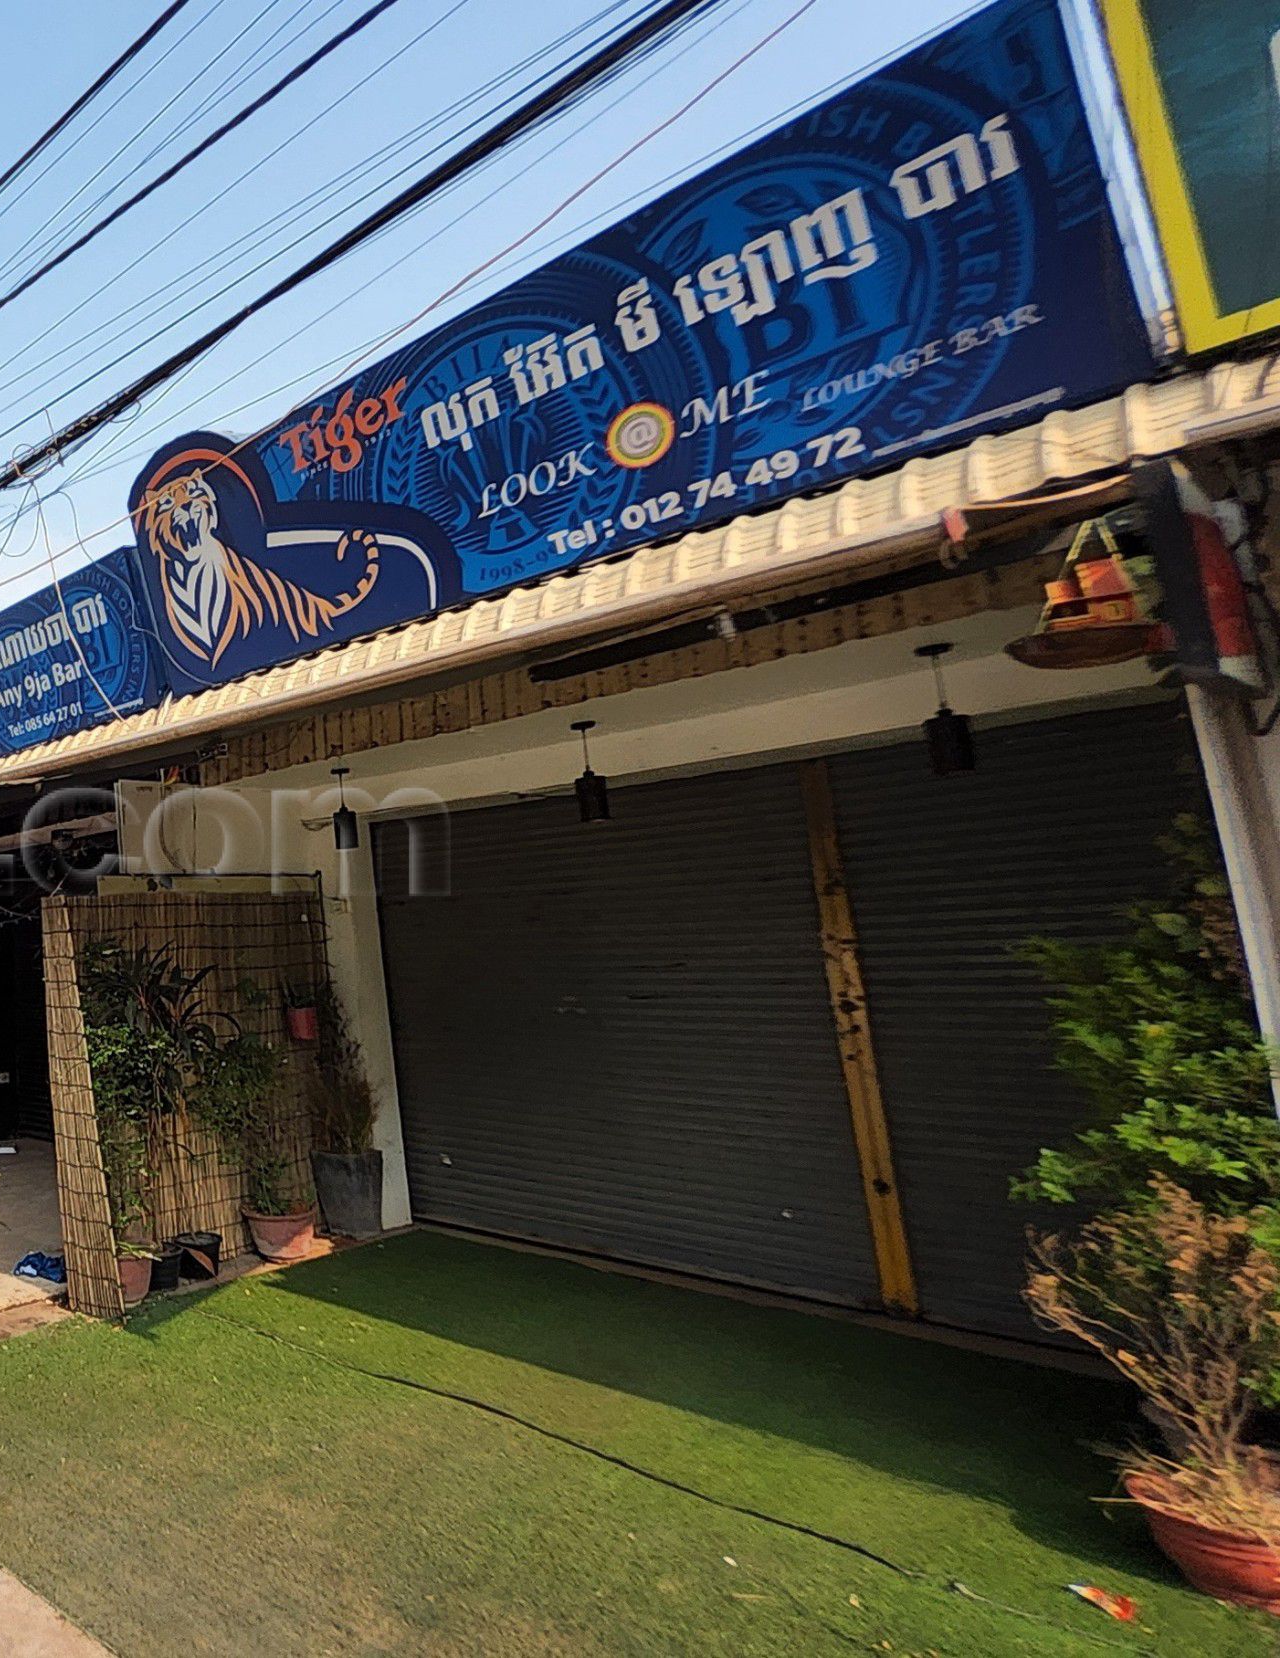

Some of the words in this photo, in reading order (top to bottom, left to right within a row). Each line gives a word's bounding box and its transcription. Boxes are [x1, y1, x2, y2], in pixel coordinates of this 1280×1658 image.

[421, 377, 501, 451] លុក
[614, 277, 661, 352] មី
[889, 113, 1020, 219] បារ
[801, 338, 945, 412] LOUNGE
[948, 303, 1047, 357] BAR
[279, 376, 408, 473] Tiger
[478, 442, 598, 519] LOOK
[680, 369, 774, 438] ME
[620, 492, 684, 531] 012
[689, 472, 737, 508] 74
[746, 449, 800, 486] 49
[808, 427, 866, 469] 72
[72, 593, 108, 634] បារ
[24, 670, 51, 701] 9ja
[52, 659, 83, 686] Bar
[25, 714, 42, 733] 085
[43, 709, 56, 727] 64
[56, 705, 68, 722] 27
[69, 700, 84, 717] 01
